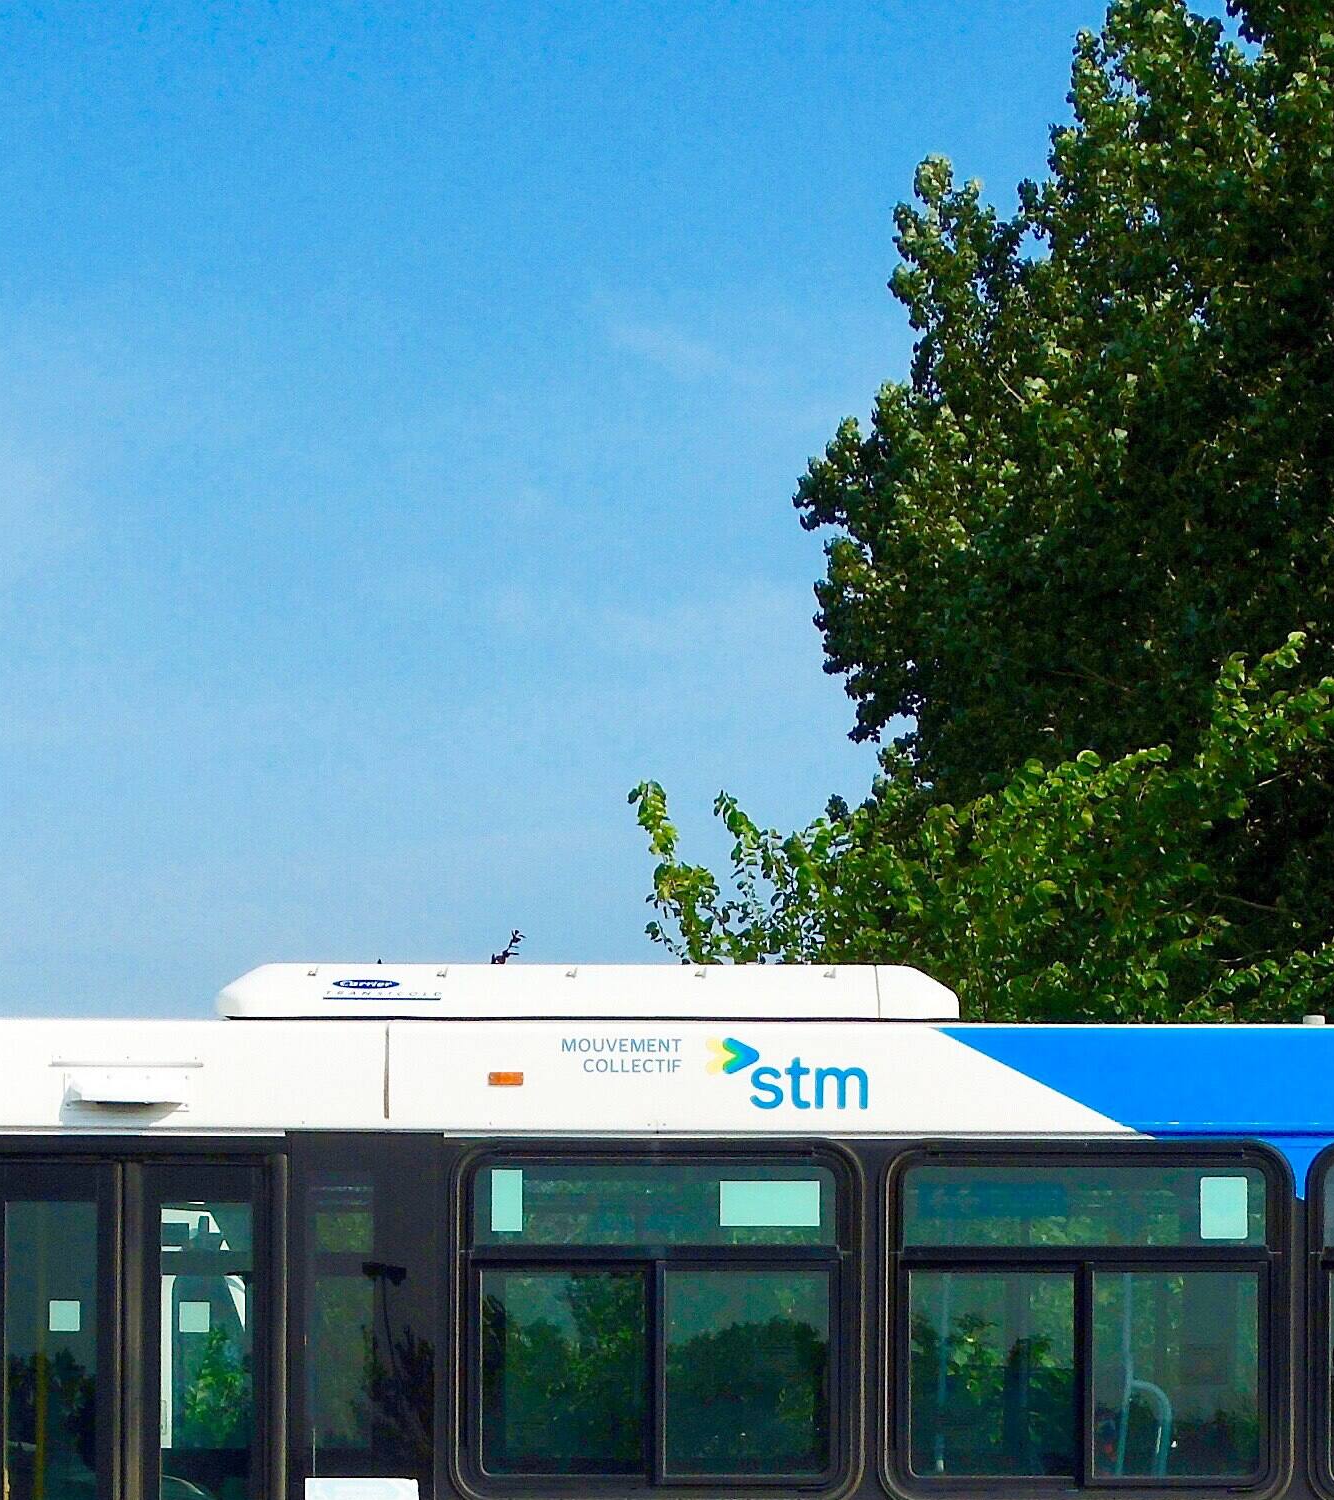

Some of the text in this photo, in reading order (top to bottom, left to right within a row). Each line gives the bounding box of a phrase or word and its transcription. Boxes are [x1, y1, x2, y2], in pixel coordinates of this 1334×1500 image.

[338, 979, 395, 988] Carrier
[561, 1038, 682, 1053] MOUVEMENT
[583, 1058, 682, 1073] COLLECTIF
[750, 1056, 868, 1109] stm
